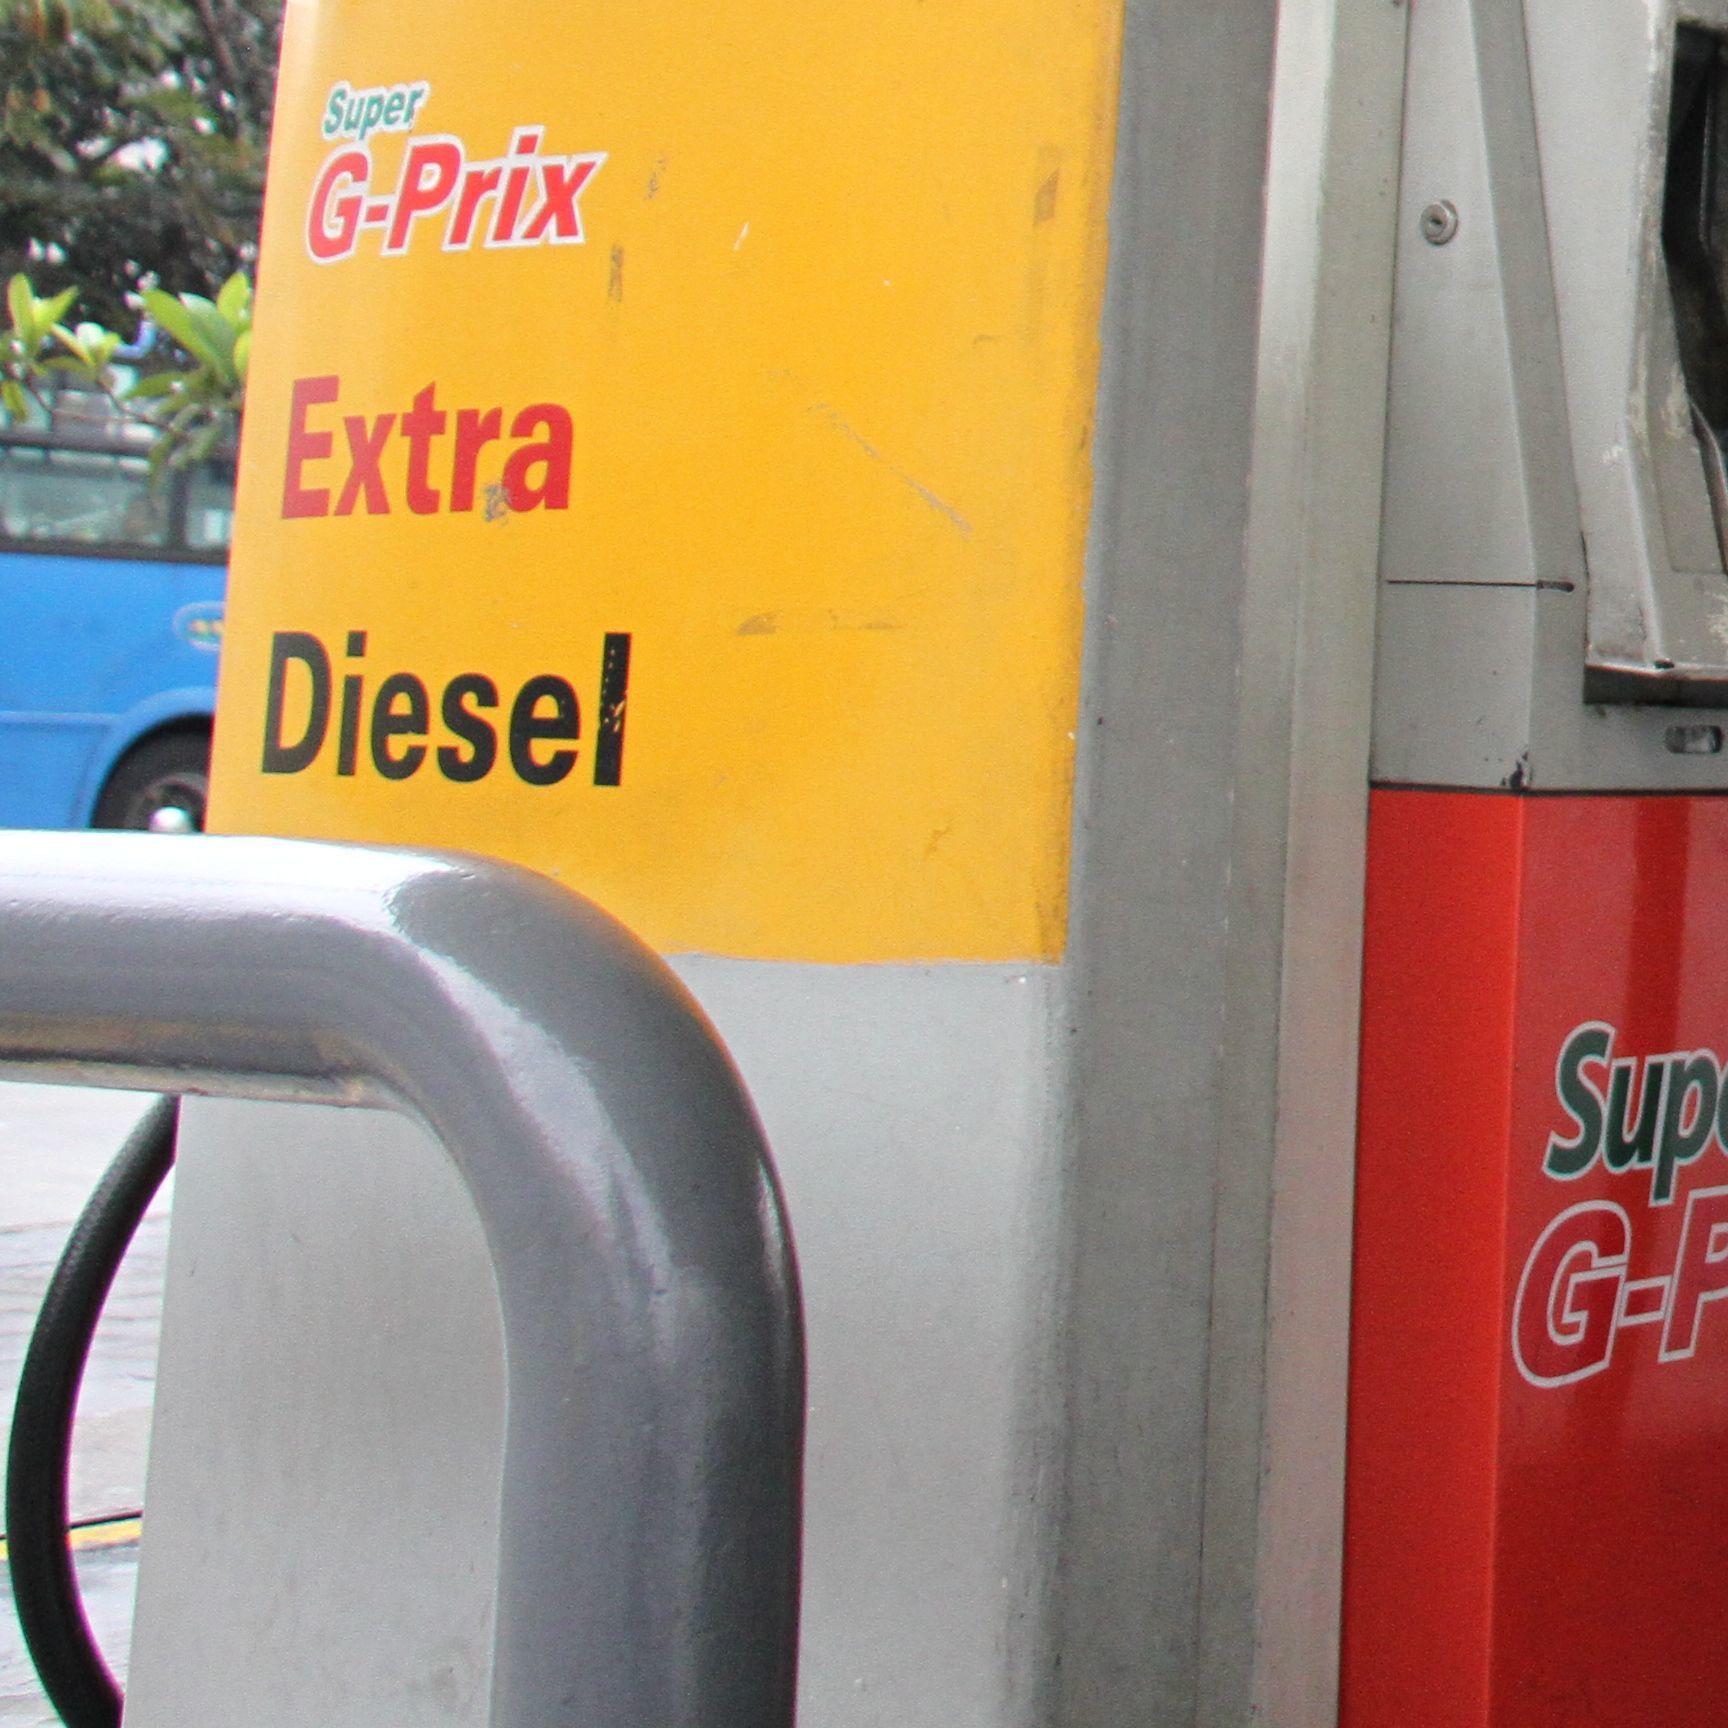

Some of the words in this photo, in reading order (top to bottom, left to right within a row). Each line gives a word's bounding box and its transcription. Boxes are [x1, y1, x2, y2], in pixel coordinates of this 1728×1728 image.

[322, 81, 429, 139] Super
[306, 125, 607, 264] G-Prix
[281, 374, 575, 520] Extra
[261, 630, 632, 787] Diesel
